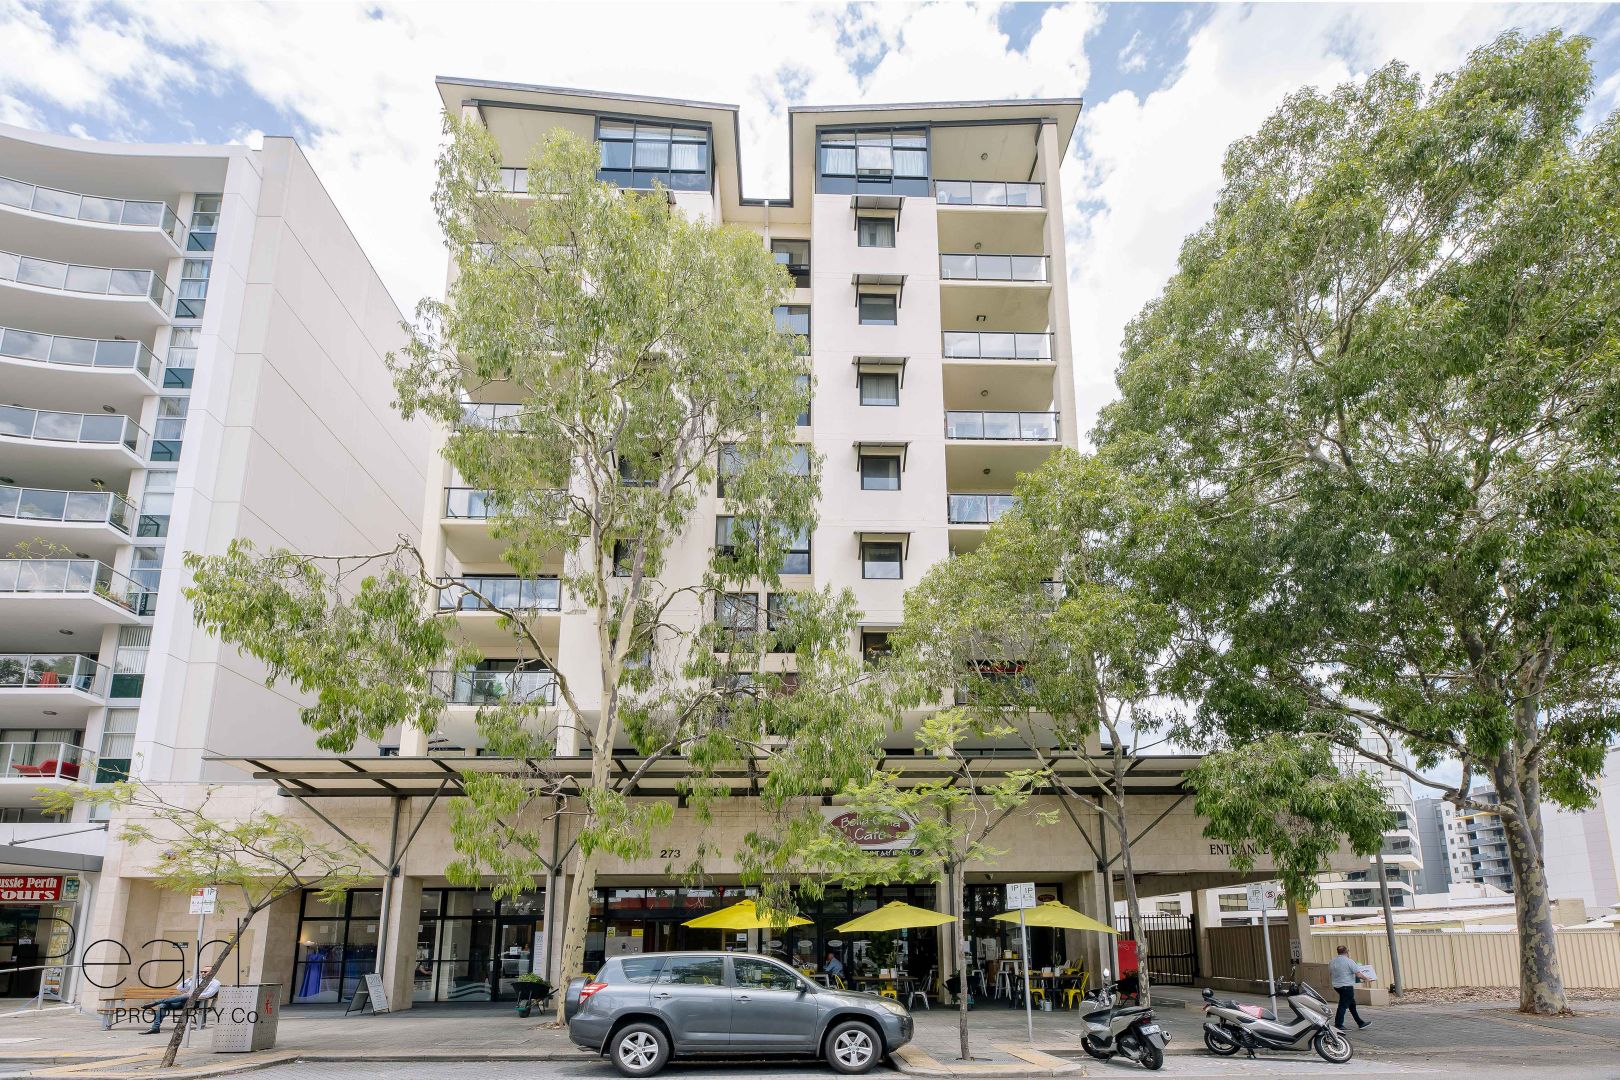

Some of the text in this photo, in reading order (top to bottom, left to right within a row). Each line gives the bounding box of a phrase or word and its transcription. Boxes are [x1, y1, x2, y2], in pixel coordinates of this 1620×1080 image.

[660, 849, 681, 859] 273
[0, 877, 24, 889] ussie
[26, 877, 57, 889] Perth
[0, 889, 55, 900] ours
